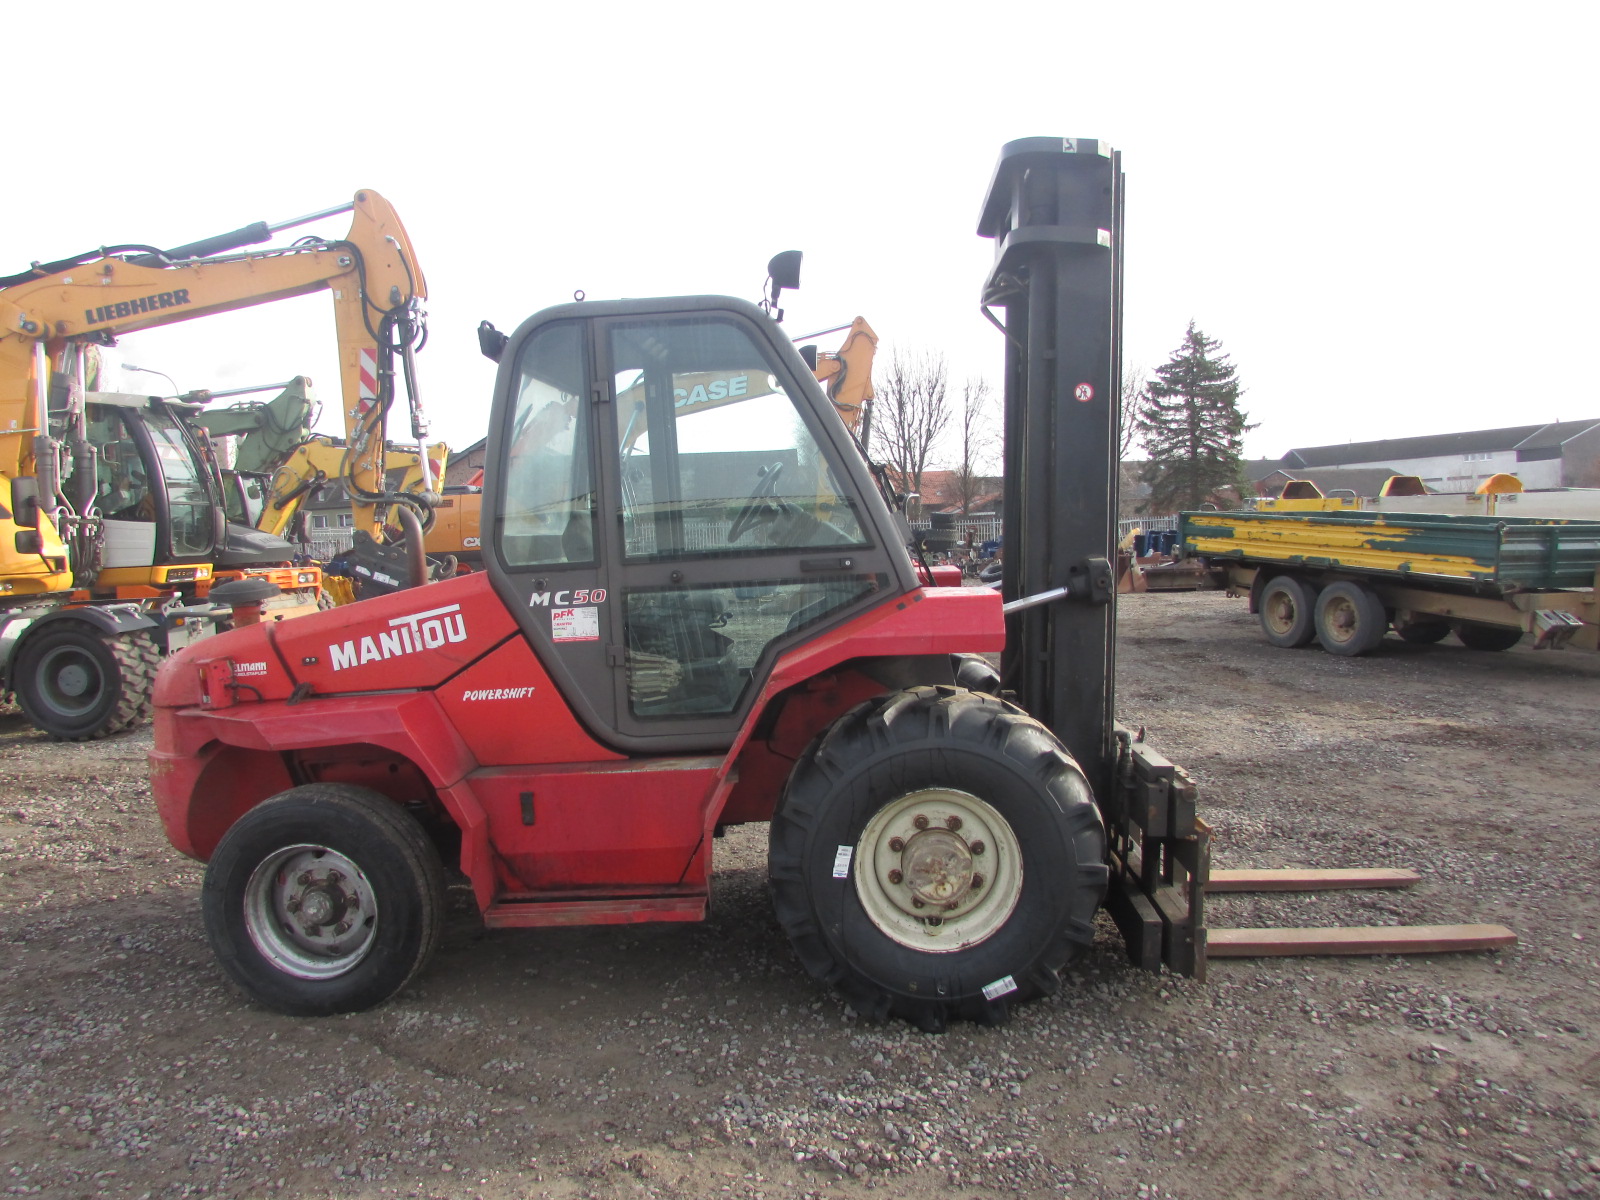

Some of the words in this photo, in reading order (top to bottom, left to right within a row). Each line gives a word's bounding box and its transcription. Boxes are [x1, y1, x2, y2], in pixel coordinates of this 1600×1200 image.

[85, 288, 191, 325] LIEBHERR
[674, 375, 748, 408] CASE
[553, 609, 575, 621] PFK
[328, 603, 468, 672] MANITOU
[462, 686, 535, 701] POWERSHIFT
